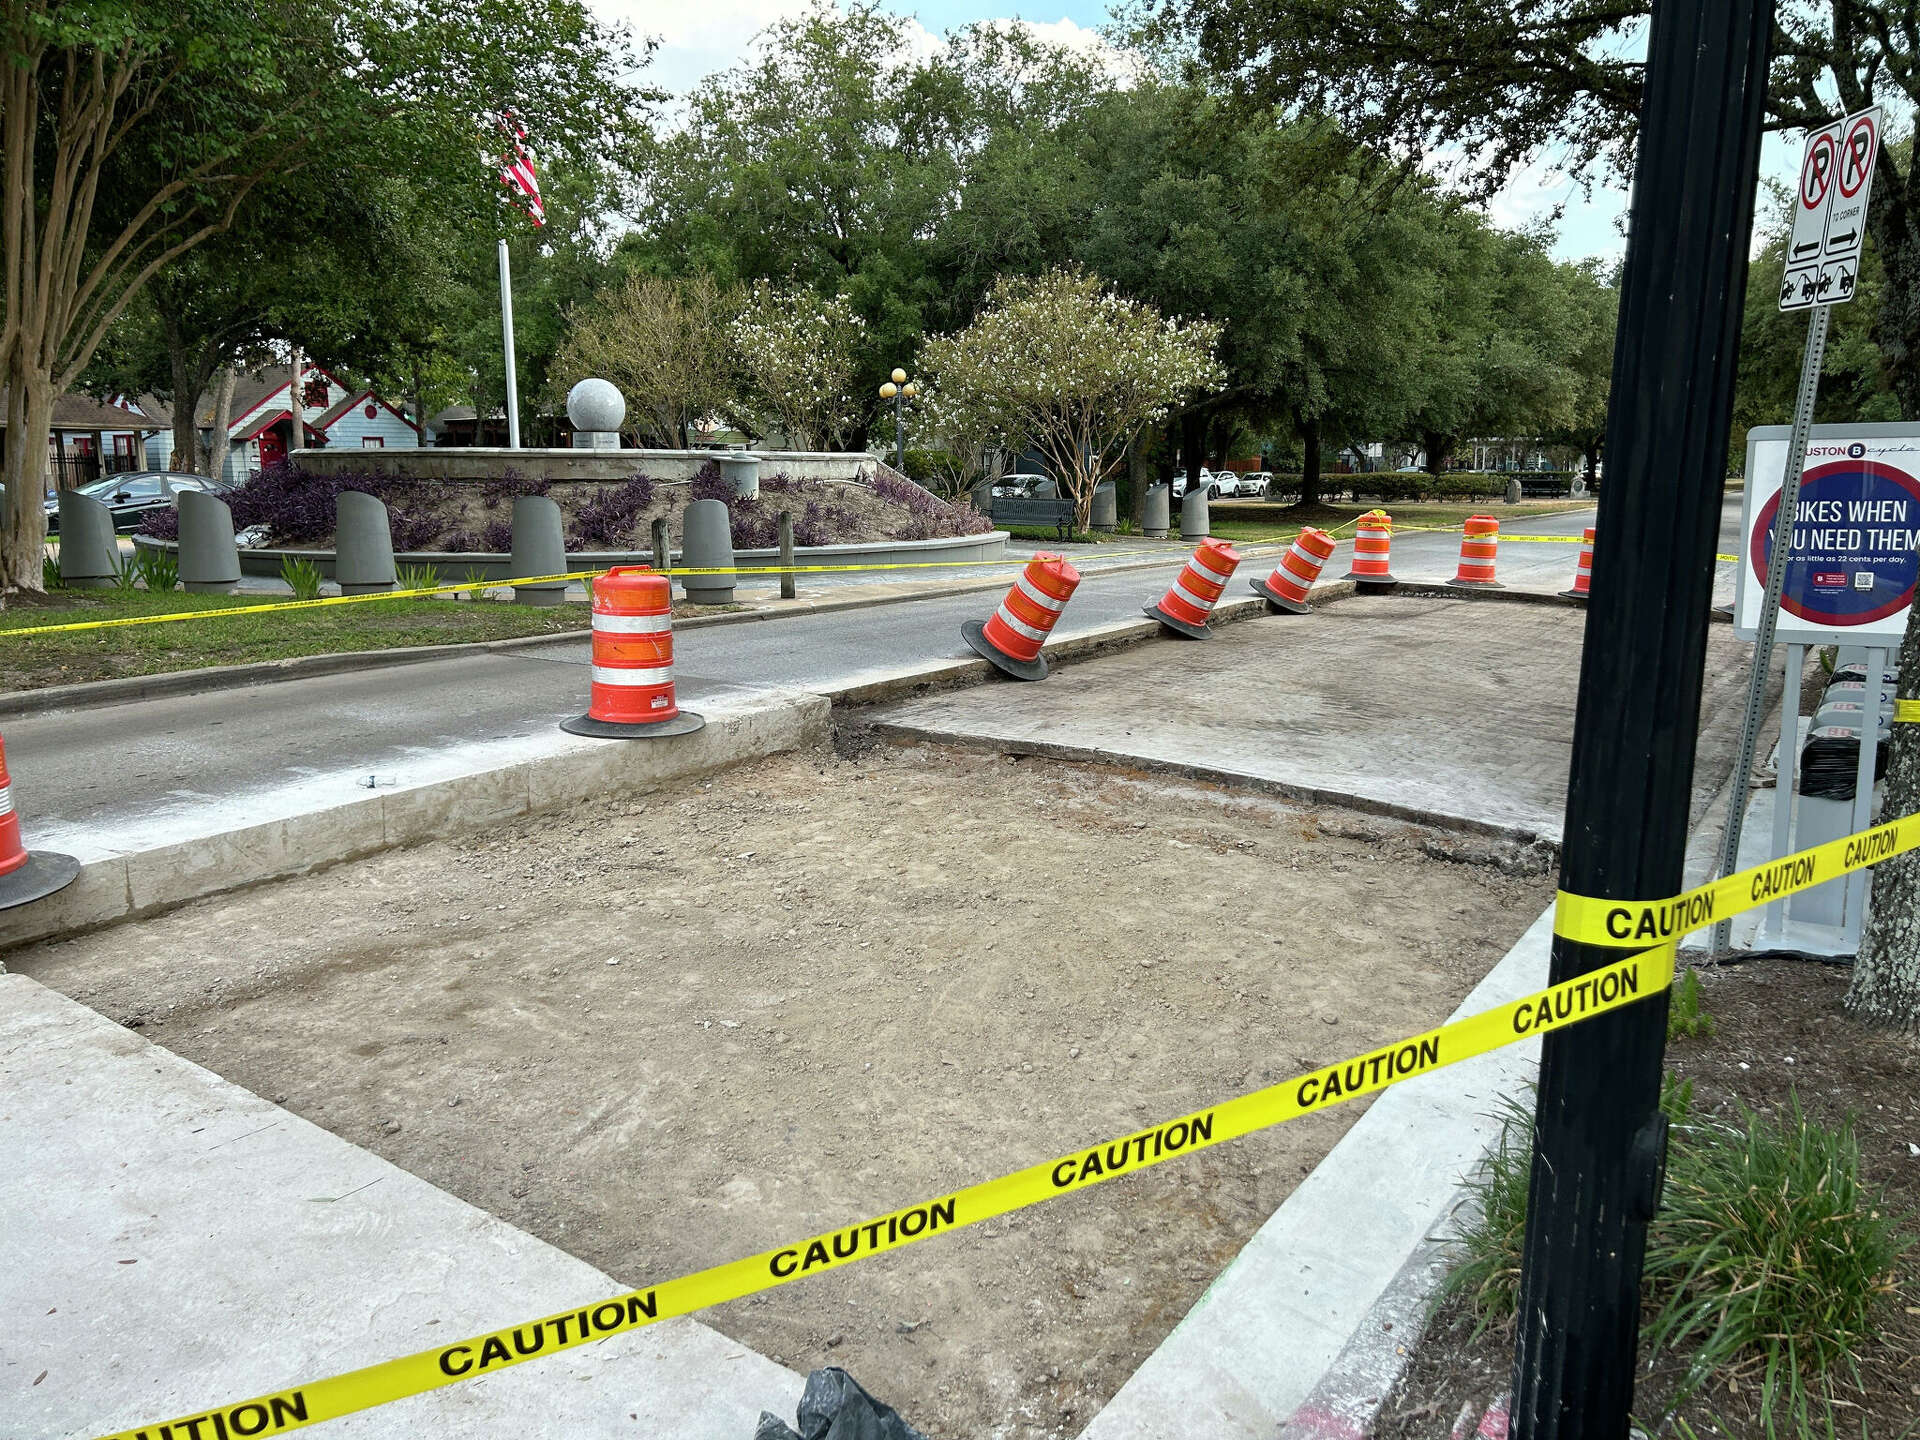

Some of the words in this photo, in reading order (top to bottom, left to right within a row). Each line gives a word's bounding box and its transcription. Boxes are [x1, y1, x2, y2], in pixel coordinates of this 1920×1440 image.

[1811, 529, 1861, 550] NEED
[1848, 501, 1907, 522] WHEN
[1751, 855, 1816, 901] CAUTION
[1844, 827, 1898, 869] CAUTION
[1606, 889, 1714, 939] CAUTION
[1513, 963, 1638, 1034] CAUTION
[1297, 1036, 1440, 1107] CAUTION
[1051, 1113, 1214, 1188] CAUTION
[769, 1198, 956, 1277] CAUTION
[439, 1291, 658, 1377] CAUTION
